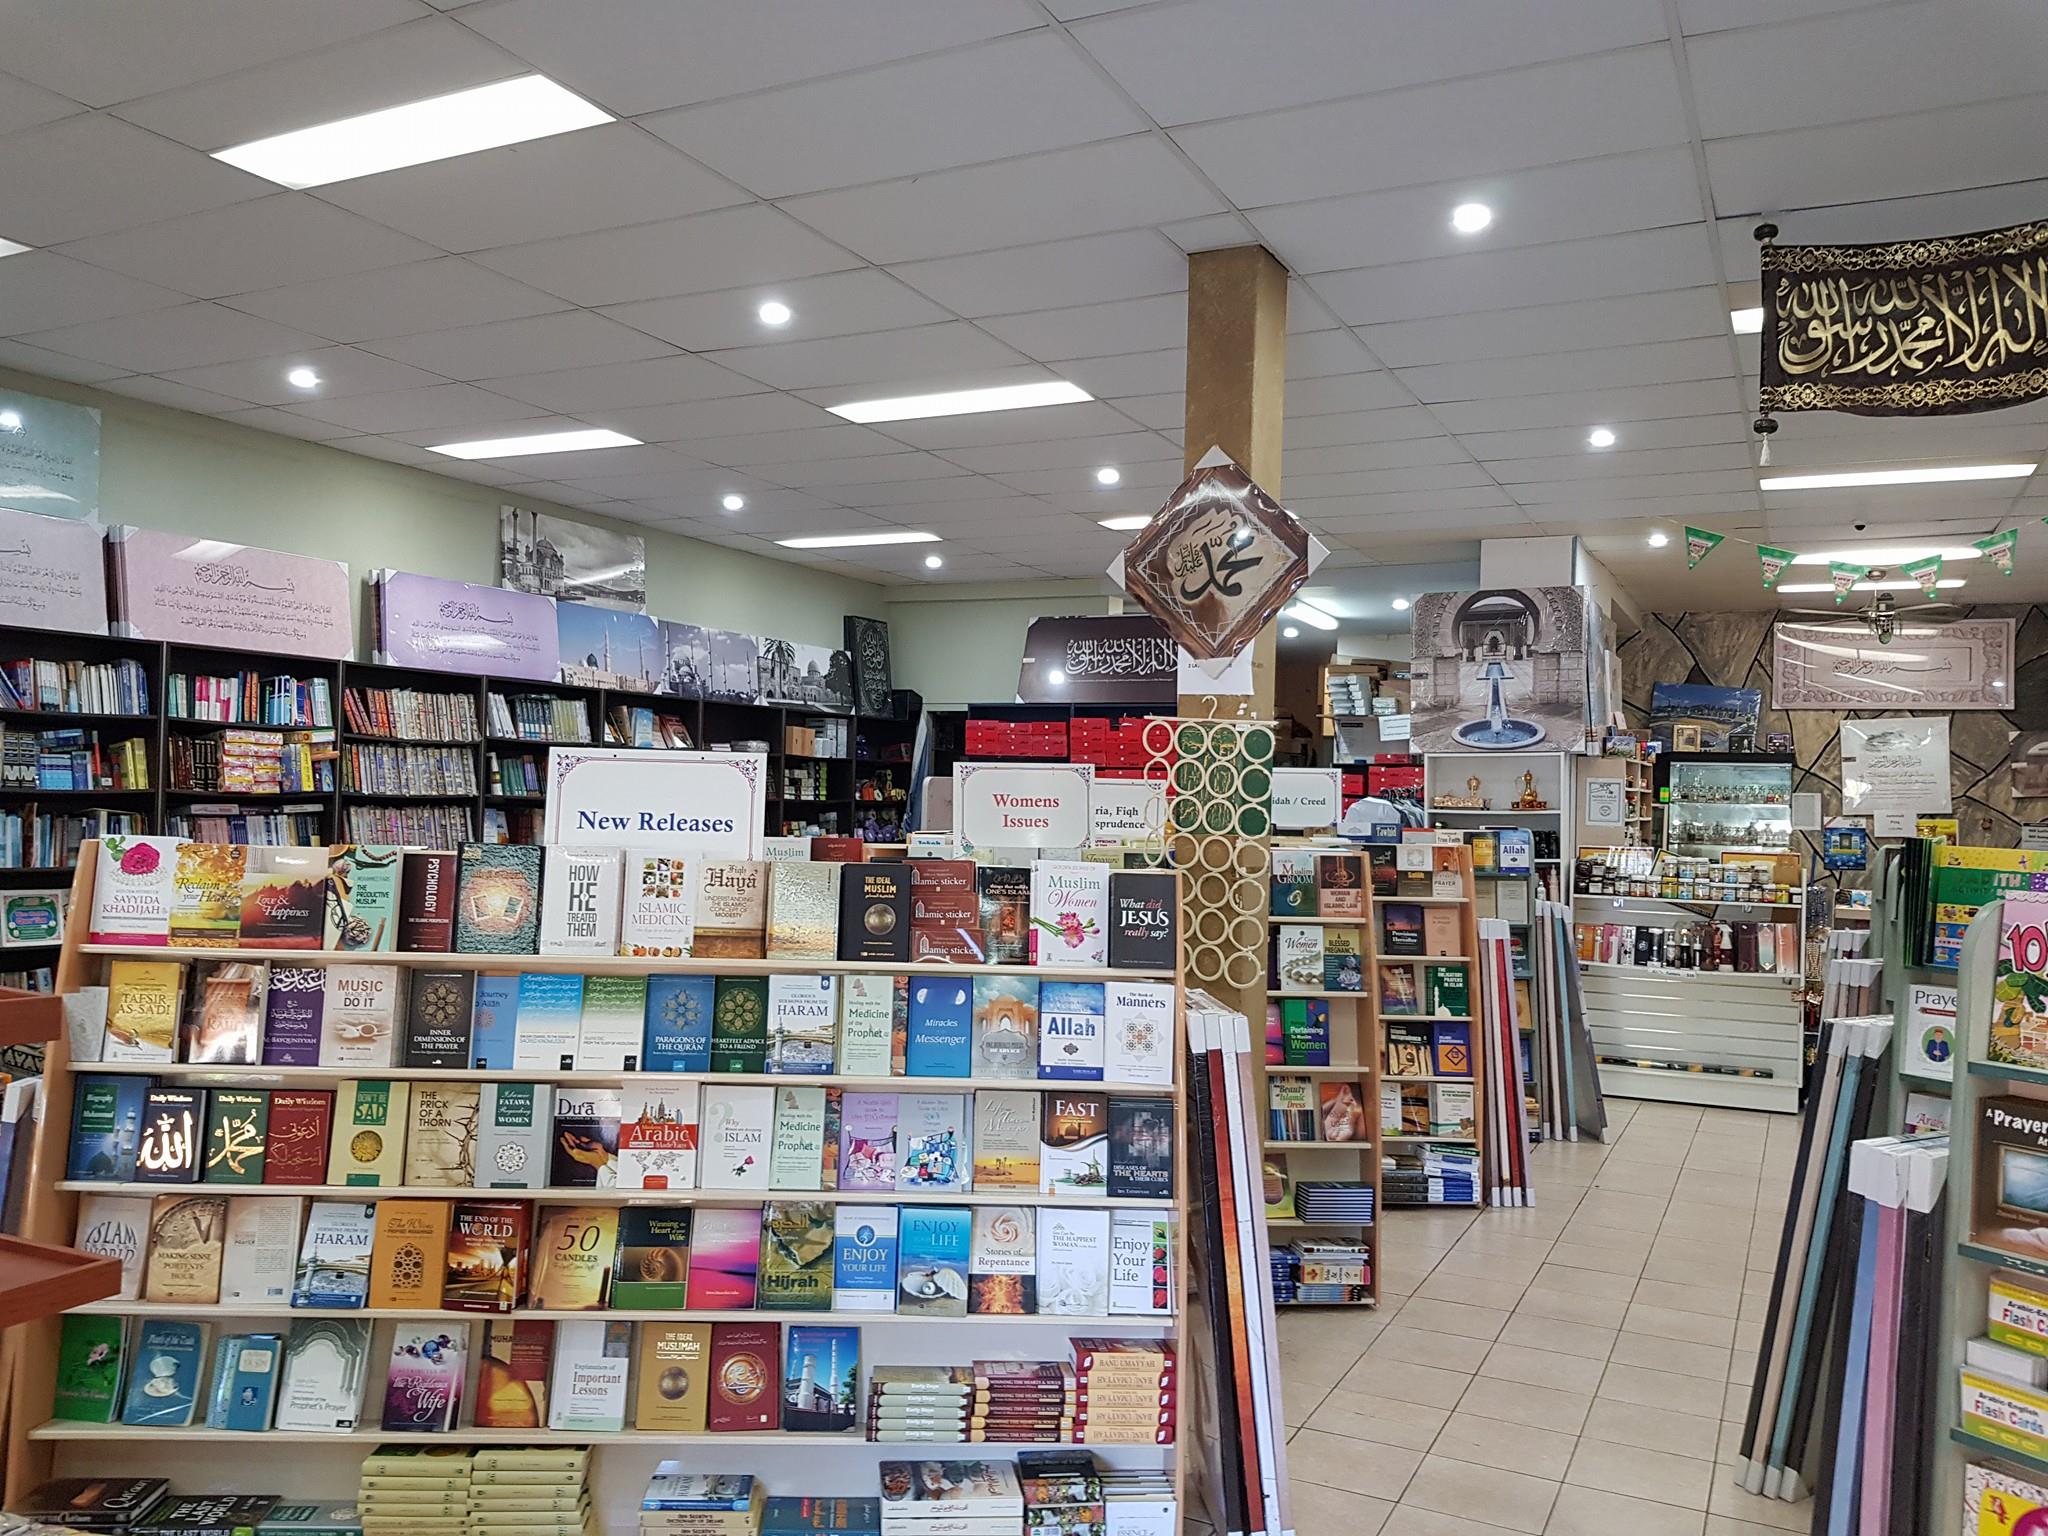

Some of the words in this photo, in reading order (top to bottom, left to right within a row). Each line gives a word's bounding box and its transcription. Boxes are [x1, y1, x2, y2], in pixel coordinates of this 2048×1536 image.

[992, 794, 1059, 808] Womens
[1272, 796, 1290, 805] idah
[1301, 797, 1326, 806] Creed
[1095, 807, 1112, 817] ria,
[1116, 807, 1139, 816] Fiqh
[577, 811, 631, 830] New
[638, 812, 734, 833] Releases
[1002, 814, 1049, 828] Issues
[1095, 820, 1145, 829] sprudence
[766, 848, 804, 857] Muslim
[1503, 846, 1525, 854] Allah
[569, 864, 600, 882] HOW
[1283, 864, 1312, 875] Muslim
[176, 877, 220, 892] Reclaim
[941, 877, 966, 885] sticker
[1048, 876, 1100, 889] Muslim
[1277, 874, 1313, 884] GROOM
[429, 858, 440, 913] PSYCHOLOGY
[864, 885, 896, 893] MUSLIM
[113, 895, 160, 905] SAYYIDA
[183, 894, 199, 903] your
[256, 894, 278, 905] Love
[278, 895, 289, 904] &
[569, 882, 596, 912] HE
[1047, 889, 1097, 908] Women
[102, 904, 160, 914] KHADIJAH
[638, 902, 686, 914] ISLAMIC
[1120, 898, 1145, 909] What
[1146, 898, 1162, 908] did
[263, 906, 309, 922] Happiness
[567, 912, 597, 923] TREATED
[632, 913, 691, 926] MEDICINE
[945, 909, 972, 919] sticker
[1120, 910, 1169, 927] JESUS
[567, 922, 596, 937] THEM
[1124, 927, 1149, 940] really
[1150, 928, 1169, 940] say?
[1285, 937, 1317, 949] Women
[338, 979, 383, 992] MUSIC
[122, 993, 166, 1004] TAFSIR
[344, 998, 359, 1007] DO
[363, 998, 374, 1007] IT
[1116, 997, 1166, 1009] Manners
[1915, 990, 1957, 1009] Praye
[777, 1005, 829, 1017] HARAM
[849, 1008, 889, 1019] Medicine
[924, 1019, 958, 1028] Miracles
[1048, 1017, 1096, 1037] Allah
[847, 1028, 883, 1039] Prophet
[1290, 1027, 1323, 1035] Pertaining
[655, 1036, 693, 1044] PARAGONS
[915, 1034, 966, 1045] Messenger
[1291, 1040, 1326, 1049] Women
[151, 1095, 166, 1103] Daily
[219, 1096, 237, 1104] Daily
[420, 1091, 437, 1100] THE
[275, 1097, 295, 1106] Daily
[420, 1100, 448, 1109] PRICK
[500, 1099, 530, 1107] FATAWA
[354, 1103, 386, 1119] SAD
[420, 1109, 435, 1118] OF
[436, 1109, 443, 1118] A
[1055, 1100, 1099, 1117] FAST
[1986, 1108, 1993, 1118] A
[419, 1118, 451, 1127] THORN
[497, 1116, 530, 1124] WOMEN
[725, 1118, 740, 1127] Why
[780, 1122, 821, 1133] Medicine
[630, 1127, 689, 1142] Arabic
[724, 1132, 762, 1143] ISLAM
[778, 1141, 814, 1151] Prophet
[460, 1215, 473, 1223] THE
[474, 1215, 489, 1223] END
[85, 1220, 137, 1245] ISLAM
[460, 1223, 513, 1237] WORLD
[913, 1220, 960, 1234] ENJOY
[314, 1232, 368, 1247] HARAM
[557, 1225, 600, 1251] 50
[931, 1234, 959, 1247] LIFE
[1113, 1237, 1150, 1251] Enjoy
[843, 1248, 888, 1263] ENJOY
[985, 1247, 1012, 1256] Stories
[1013, 1247, 1023, 1256] of
[555, 1254, 598, 1263] CANDLES
[978, 1257, 1030, 1268] Repentance
[1113, 1254, 1146, 1267] Your
[841, 1263, 868, 1272] YOUR
[869, 1264, 888, 1272] LIFE
[1113, 1269, 1139, 1282] Life
[766, 1275, 819, 1290] Hijrah
[2003, 1308, 2032, 1328] Flash
[665, 1333, 677, 1341] THE
[657, 1342, 700, 1351] MUSLIMAH
[573, 1372, 621, 1384] Important
[572, 1384, 608, 1395] Lessons
[406, 1387, 447, 1422] Wife
[1975, 1400, 2005, 1420] Flash
[2009, 1412, 2044, 1434] Cards
[200, 1497, 238, 1525] WORLD
